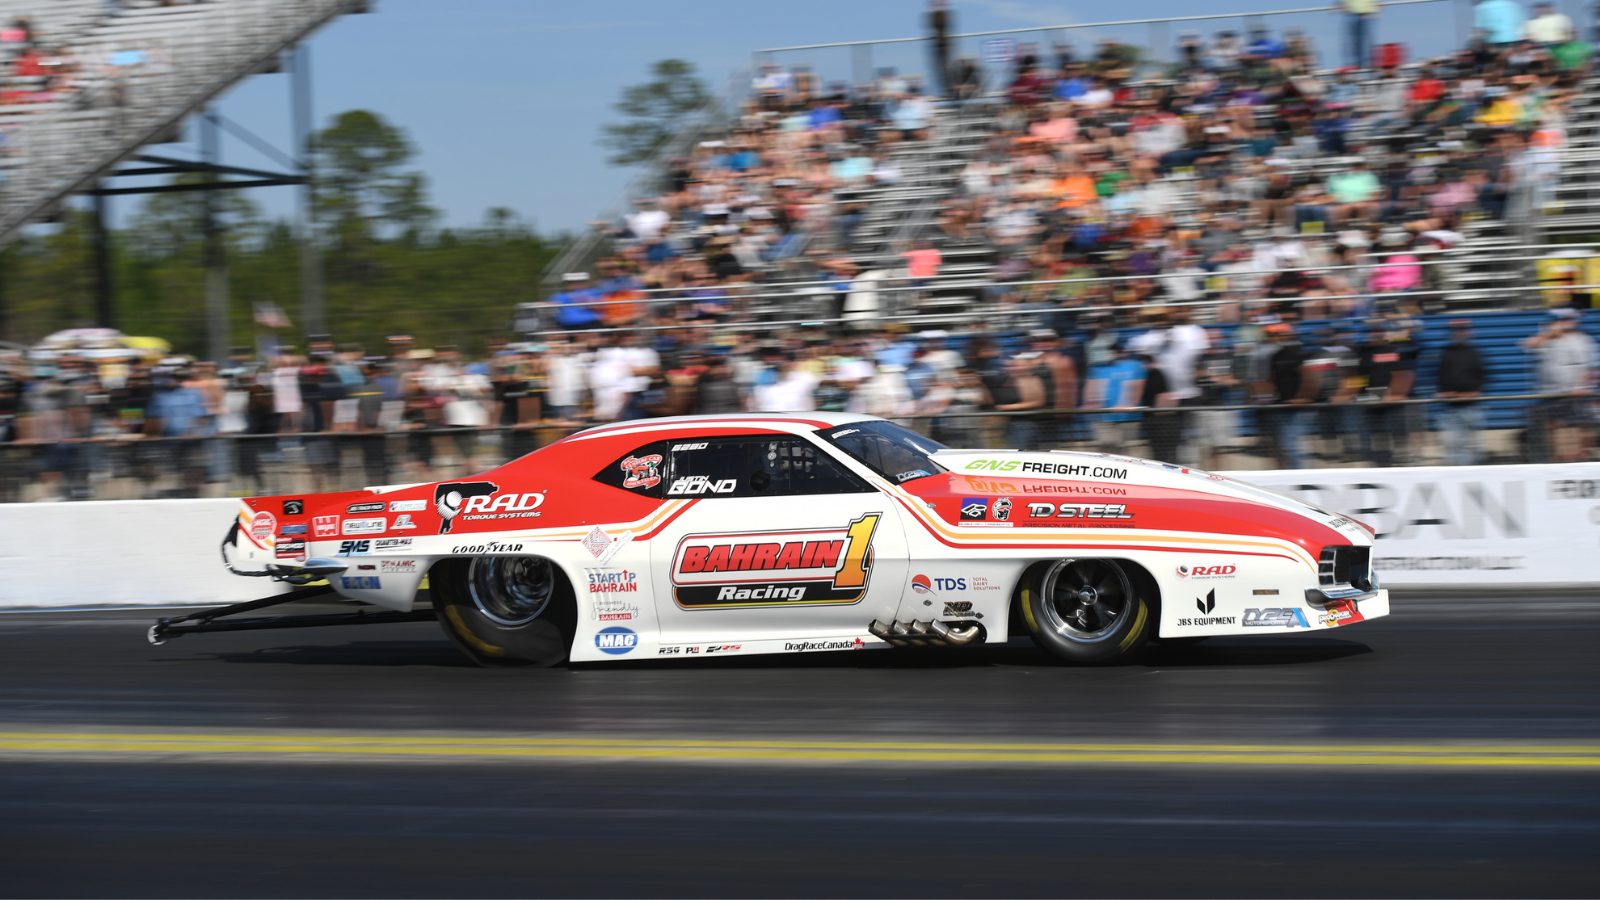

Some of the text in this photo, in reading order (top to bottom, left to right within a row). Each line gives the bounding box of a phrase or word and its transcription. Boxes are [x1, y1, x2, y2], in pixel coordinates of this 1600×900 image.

[965, 459, 1127, 479] GNS FREIGHT.COM
[667, 479, 737, 495] BOND
[464, 493, 544, 513] RAD
[1026, 502, 1134, 518] TD STEEL
[498, 511, 542, 519] SYSTEMS
[339, 540, 370, 555] SMS
[452, 541, 523, 555] GOODYEAR
[832, 514, 879, 588] 1
[679, 540, 844, 573] BAHRAIN
[1191, 565, 1236, 576] RAD
[589, 582, 637, 593] BAHRAIN
[934, 578, 967, 591] TDS
[717, 585, 806, 602] Racing
[1177, 616, 1236, 627] JBS EQUIPMENT
[784, 641, 853, 651] DragRaceCanada
